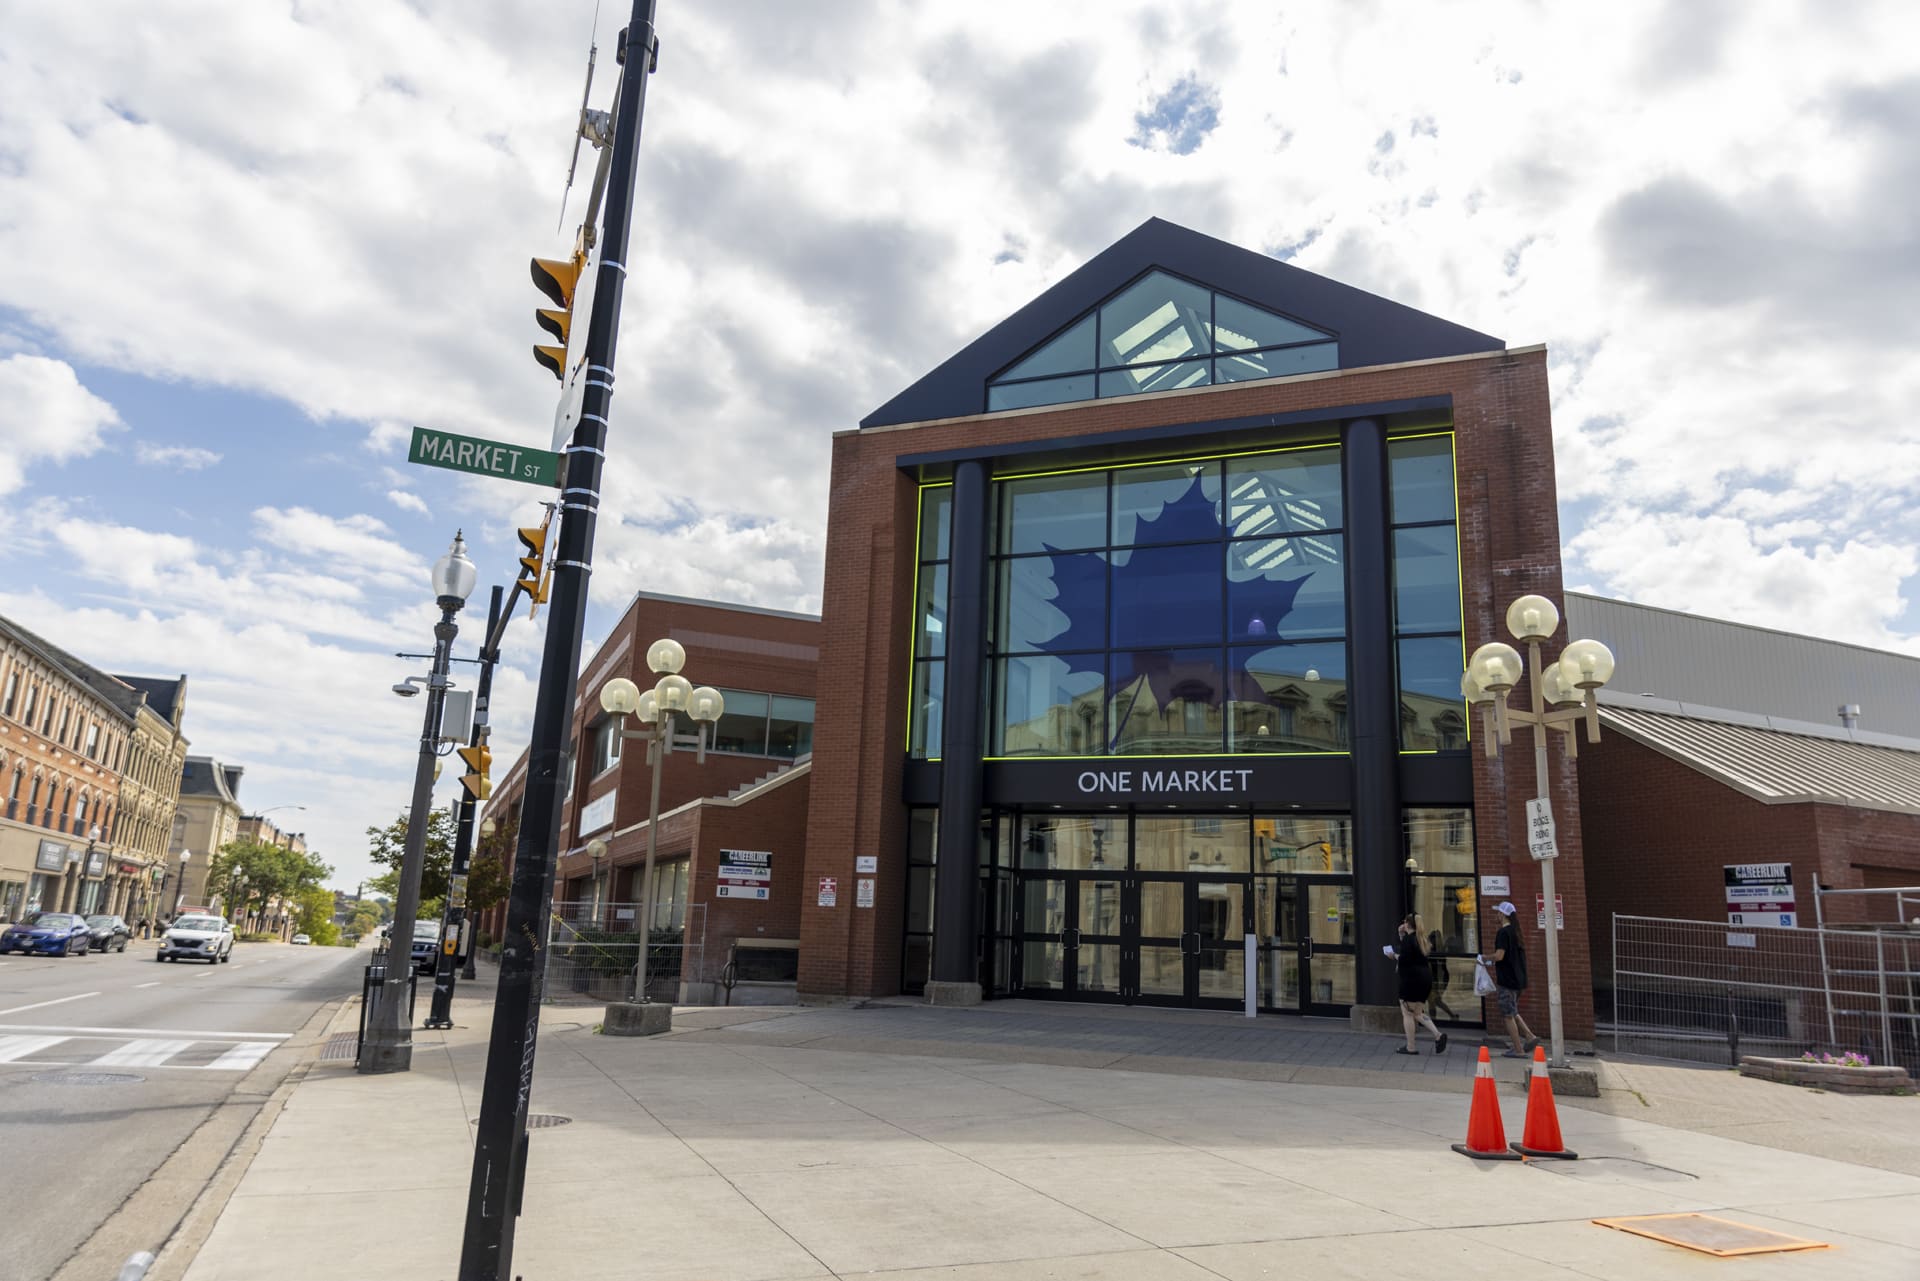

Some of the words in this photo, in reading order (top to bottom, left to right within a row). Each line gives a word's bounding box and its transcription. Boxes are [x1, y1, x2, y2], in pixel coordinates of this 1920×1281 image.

[420, 434, 522, 474] MARKET
[524, 465, 541, 478] ST
[1078, 771, 1131, 792] ONE
[1142, 770, 1253, 792] MARKET
[1736, 865, 1786, 878] CAREERLINK
